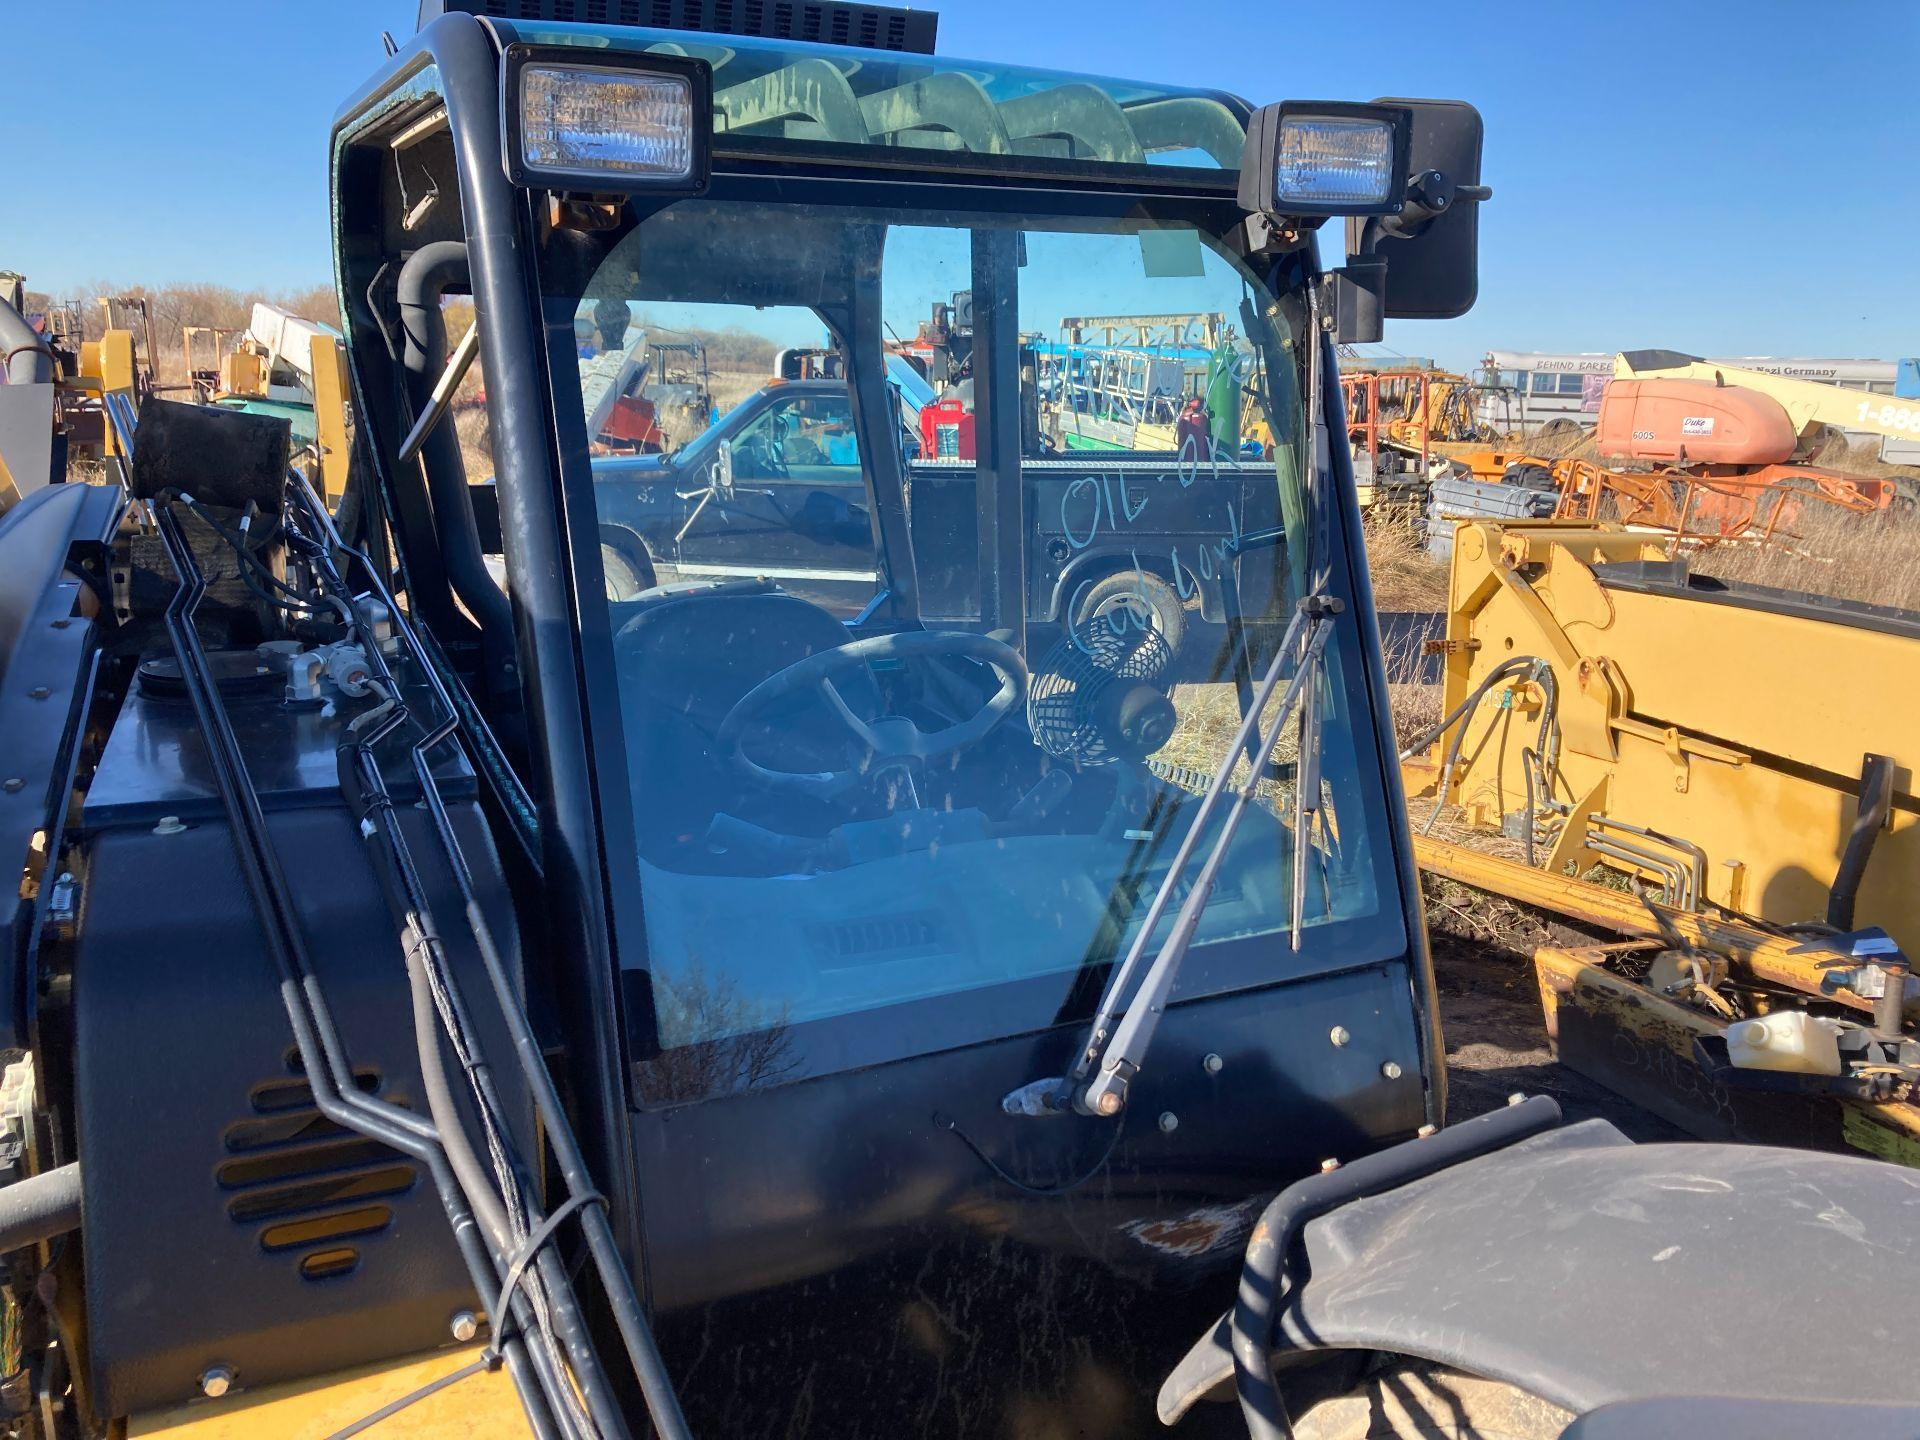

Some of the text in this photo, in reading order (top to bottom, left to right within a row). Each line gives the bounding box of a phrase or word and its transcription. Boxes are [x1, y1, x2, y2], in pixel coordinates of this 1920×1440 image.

[1784, 366, 1837, 378] Germany
[1684, 418, 1706, 427] Duke
[1632, 431, 1655, 440] 600S
